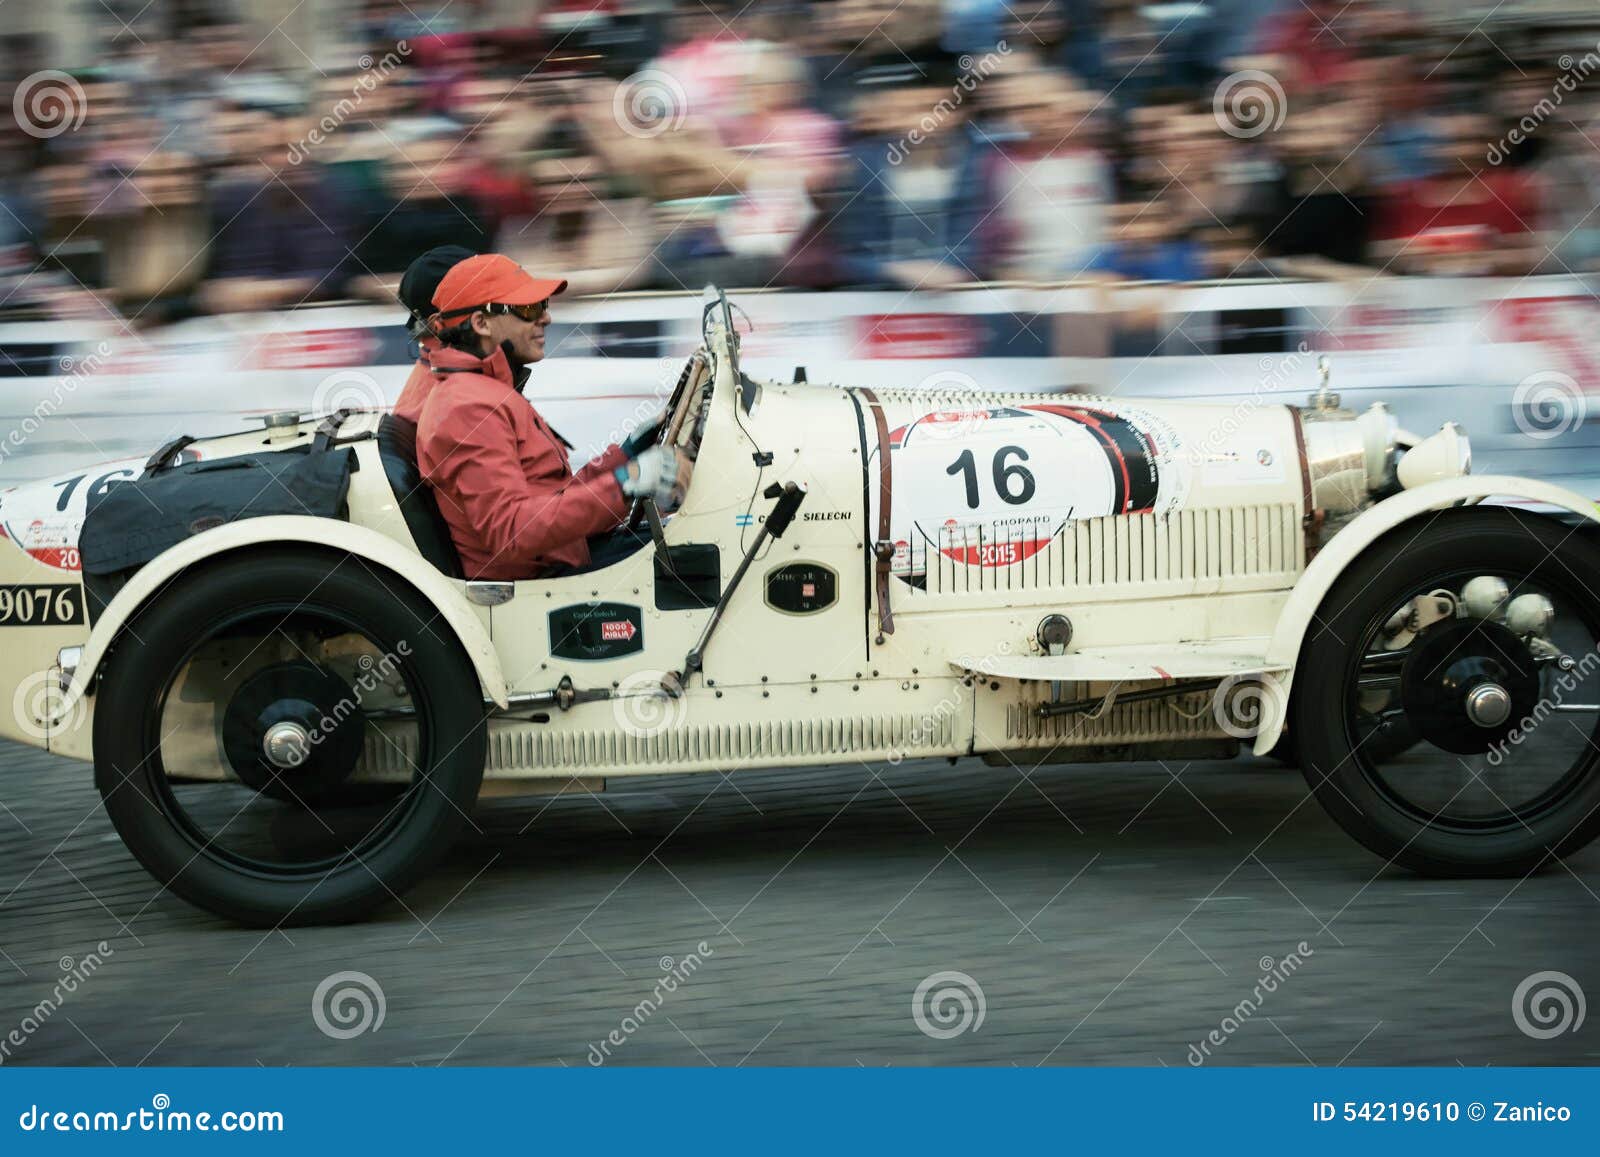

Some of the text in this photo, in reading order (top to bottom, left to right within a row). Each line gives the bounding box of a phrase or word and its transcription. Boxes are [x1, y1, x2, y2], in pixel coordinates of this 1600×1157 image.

[946, 445, 1036, 509] 16
[803, 511, 852, 521] SIELECKI
[992, 515, 1051, 527] CHOPARD
[976, 544, 1016, 565] 2015
[0, 587, 75, 623] 9076
[606, 623, 627, 631] 1000
